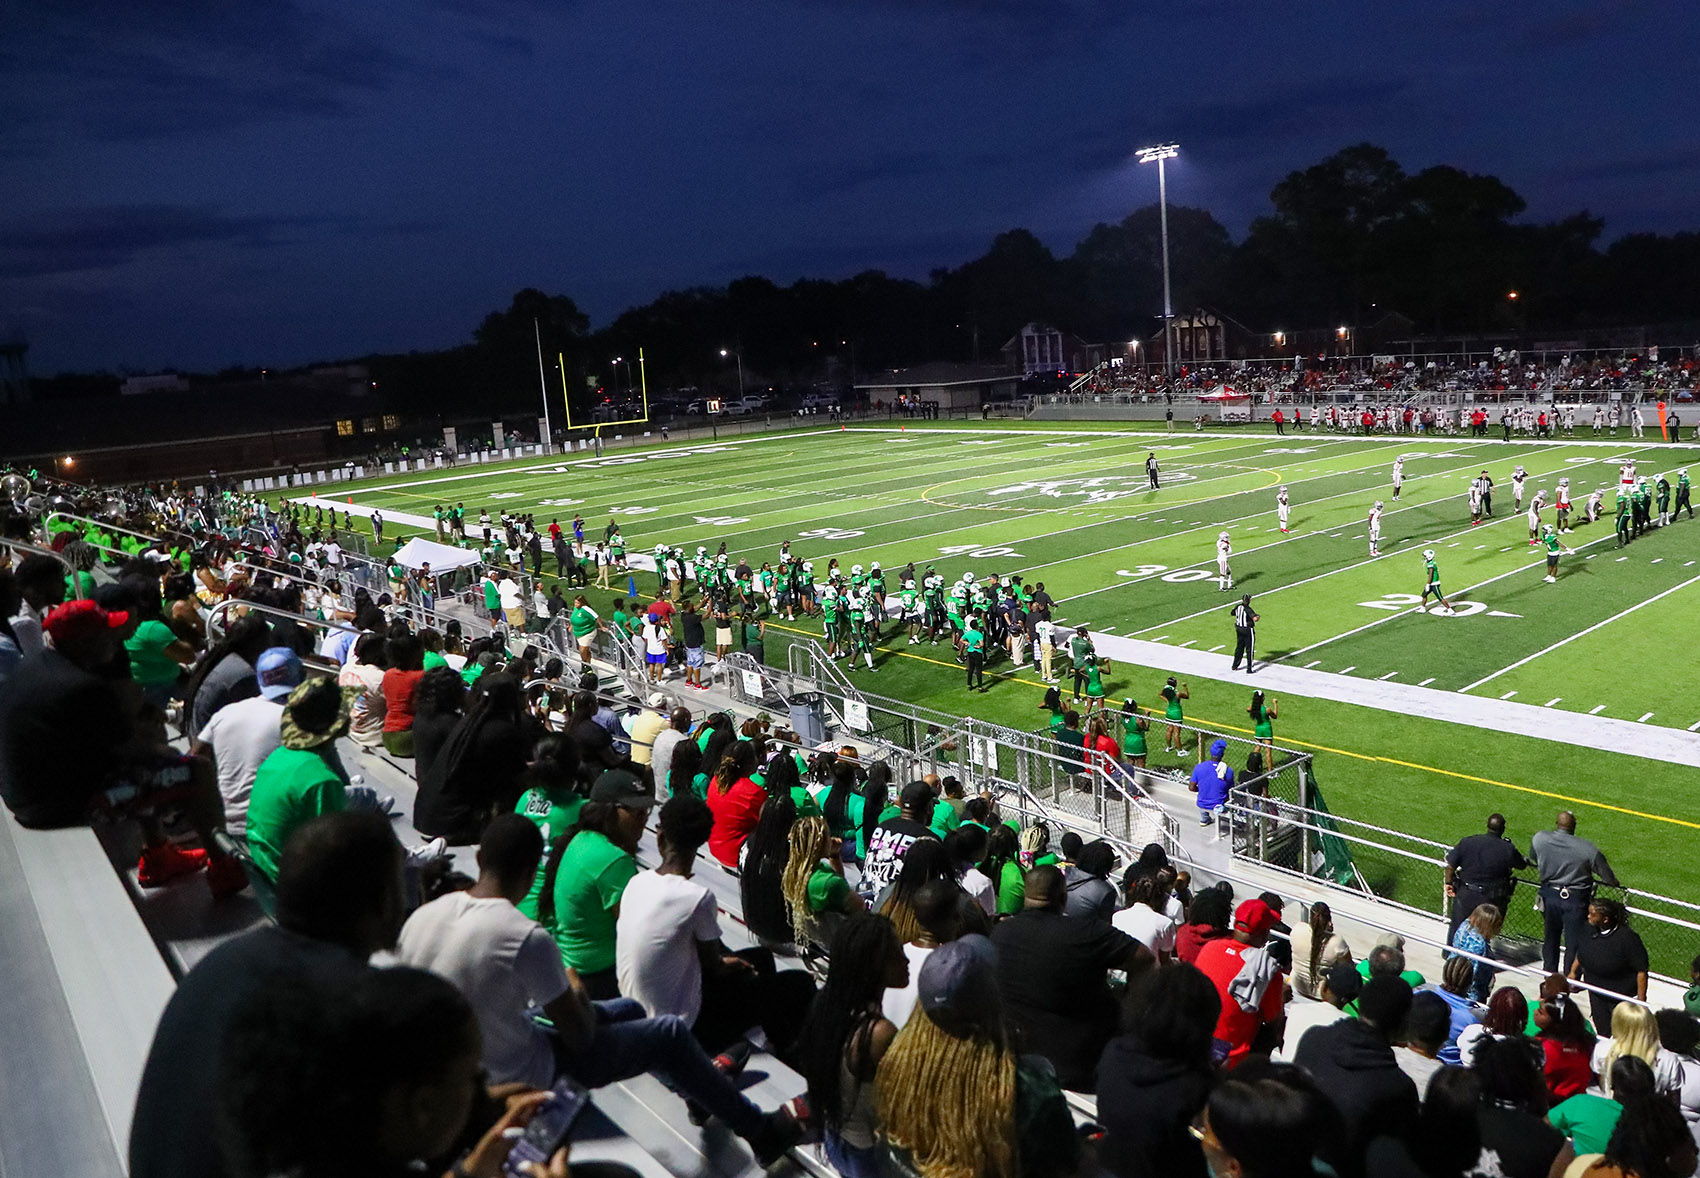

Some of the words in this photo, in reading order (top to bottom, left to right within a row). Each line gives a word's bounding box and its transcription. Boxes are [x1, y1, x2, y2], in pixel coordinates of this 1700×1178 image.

[798, 527, 866, 540] 50
[937, 544, 1015, 558] 40
[1115, 564, 1214, 583] 30
[1356, 593, 1488, 617] 20
